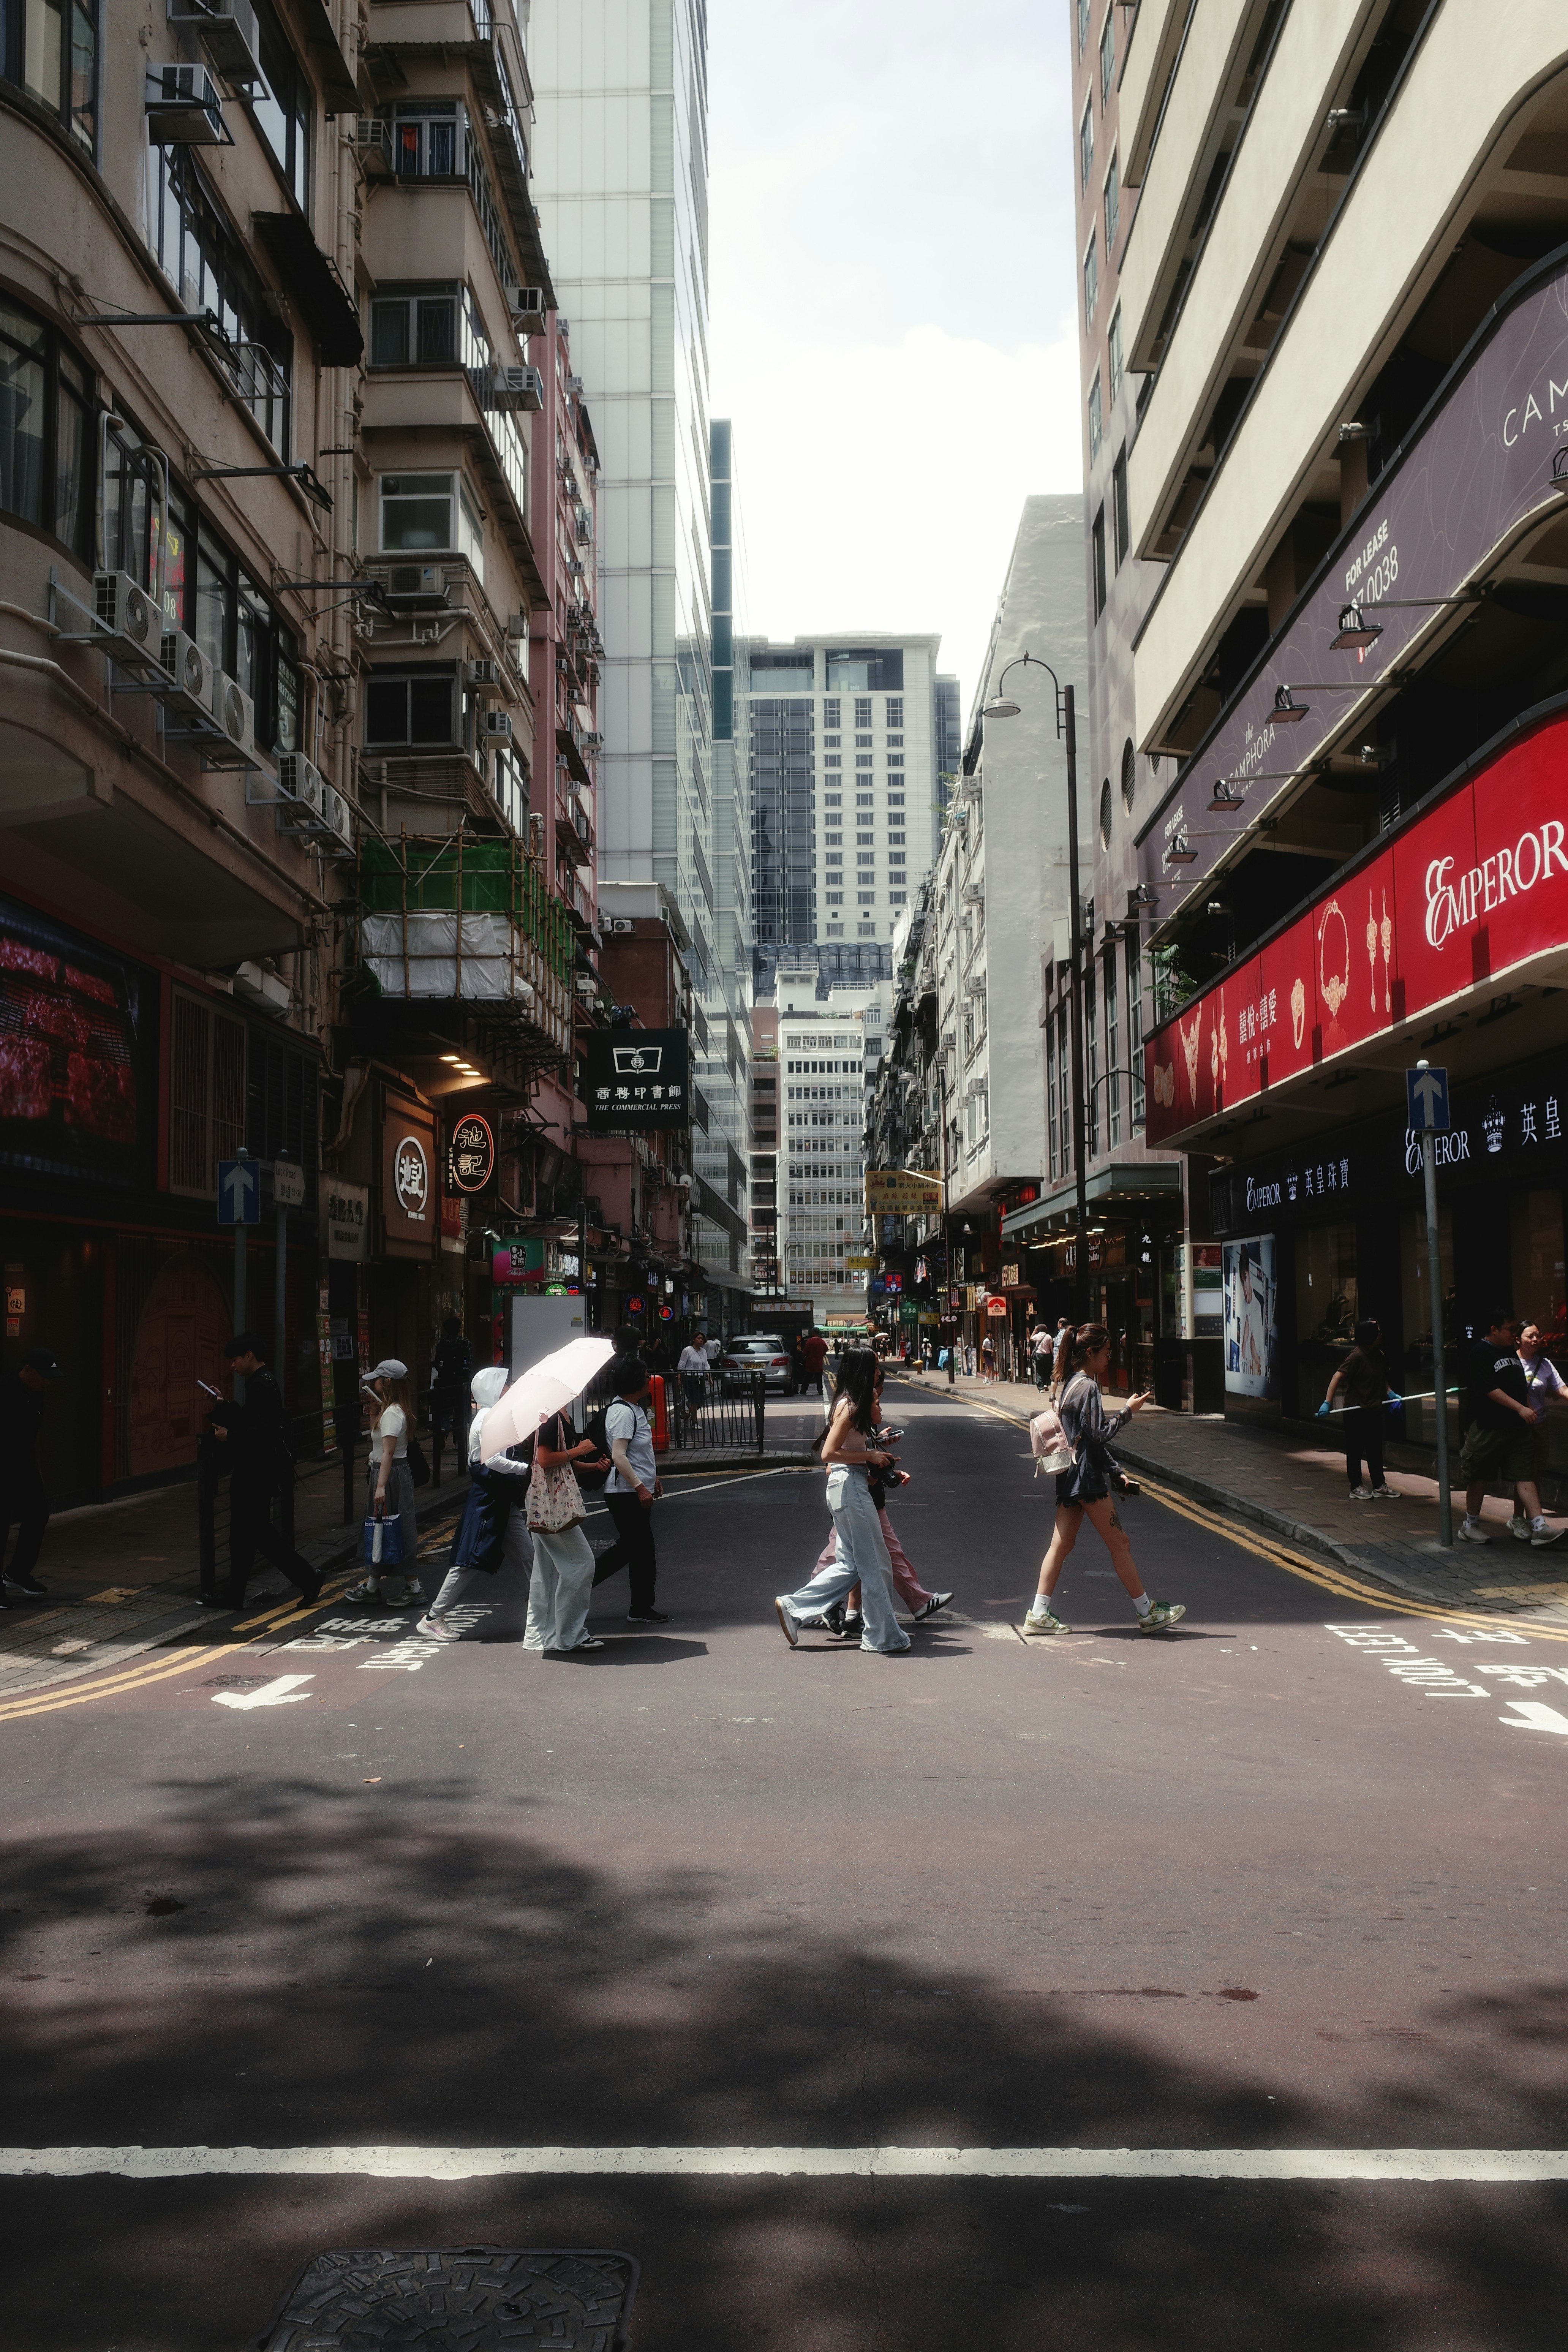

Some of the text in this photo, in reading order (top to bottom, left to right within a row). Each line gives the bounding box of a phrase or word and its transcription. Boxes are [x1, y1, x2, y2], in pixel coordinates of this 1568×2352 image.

[1345, 518, 1389, 592] FOR LEASE
[1246, 722, 1254, 745] the
[1228, 723, 1276, 795] CAMPHORA
[1172, 804, 1183, 830] LEASE
[1425, 820, 1568, 951] EMPEROR
[595, 1085, 681, 1100] 商務印書館
[1520, 1096, 1562, 1146] 英皇
[458, 1126, 486, 1176] 池記
[1405, 1127, 1471, 1178] EMEROR
[276, 1165, 296, 1179] Lock Road
[1304, 1164, 1349, 1198] 英皇珠寶
[280, 1182, 290, 1198] 樂道
[1246, 1176, 1281, 1212] EMPEROR
[517, 1249, 526, 1266] 小熊
[1141, 1234, 1152, 1263] 九龍
[629, 1298, 642, 1312] 藥
[1494, 1357, 1511, 1373] SILENT
[1324, 1625, 1420, 1653] LEFT
[1380, 1657, 1492, 1698] LOOK
